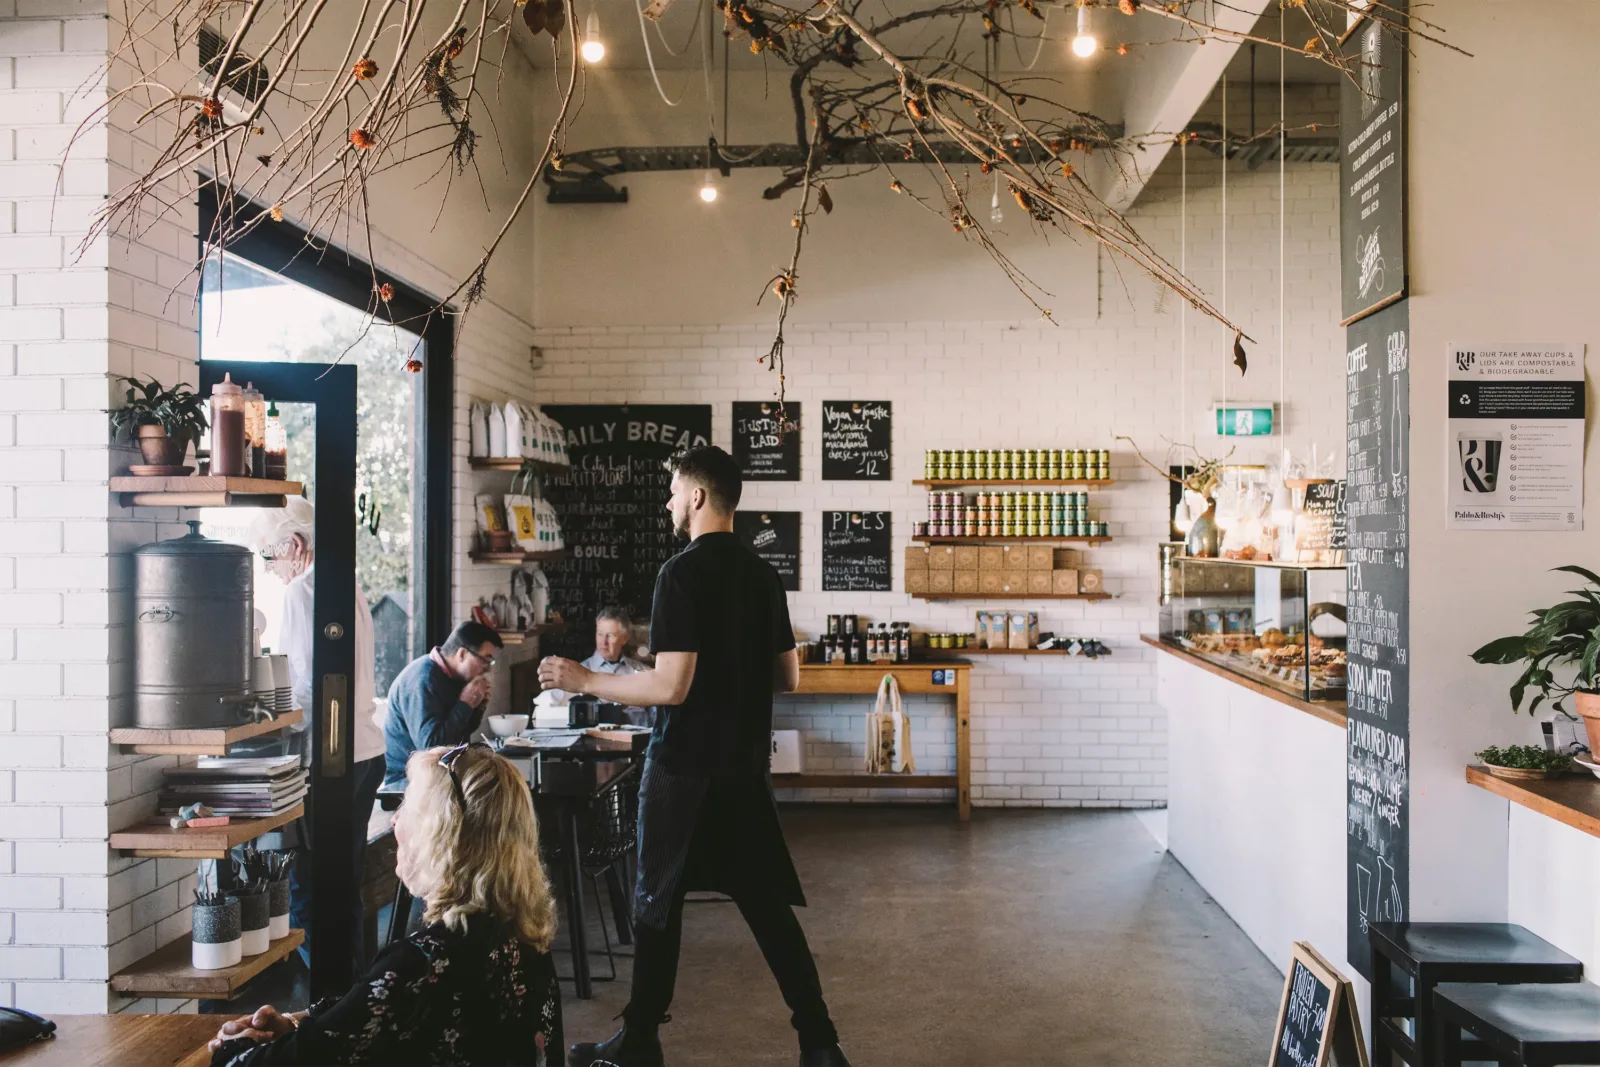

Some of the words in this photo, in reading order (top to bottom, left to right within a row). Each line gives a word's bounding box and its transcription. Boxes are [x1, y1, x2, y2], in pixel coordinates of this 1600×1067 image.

[1387, 331, 1405, 354] COLD
[1347, 342, 1368, 375] COFFEE
[1388, 347, 1408, 374] BREW
[824, 406, 851, 430] Vegan
[861, 403, 889, 420] Toastie
[840, 420, 872, 432] smoked
[567, 422, 616, 446] AILY
[627, 421, 708, 451] BREAD
[750, 435, 779, 449] LAID
[832, 512, 885, 530] PIES
[574, 546, 619, 559] BOULE
[1368, 549, 1384, 564] LATTE
[1347, 562, 1362, 591] TEA
[1348, 661, 1365, 696] SODA
[1365, 665, 1393, 704] WATER
[1348, 717, 1386, 758] FLAVOURED
[1387, 732, 1406, 769] SODA
[1351, 785, 1372, 808] CHERRY
[1377, 797, 1401, 829] GINGER
[1287, 990, 1312, 1039] PASTRY
